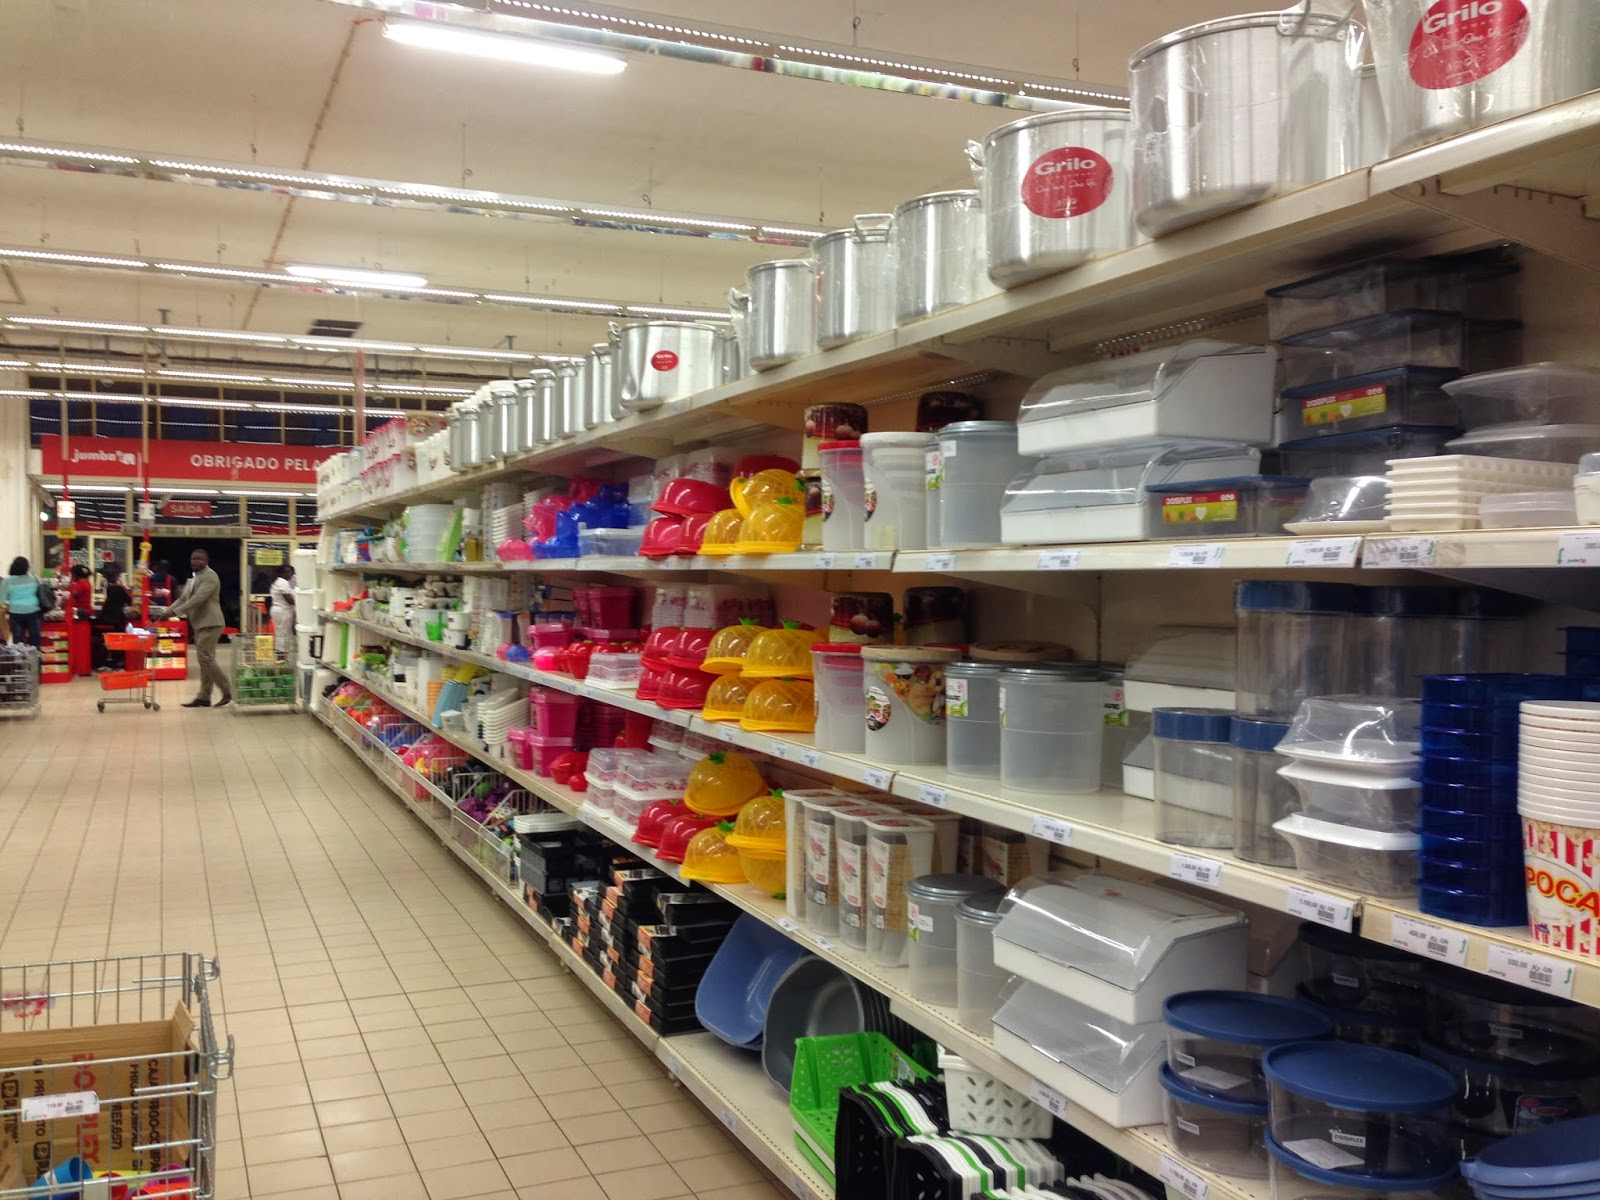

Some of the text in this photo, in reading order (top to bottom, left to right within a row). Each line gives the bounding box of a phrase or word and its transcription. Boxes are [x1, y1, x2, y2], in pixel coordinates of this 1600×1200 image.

[1423, 1, 1503, 34] Grilo
[1035, 157, 1097, 176] Grilo
[190, 454, 322, 471] OBRIGADO PELA
[1333, 1133, 1364, 1144] DOMPLEX
